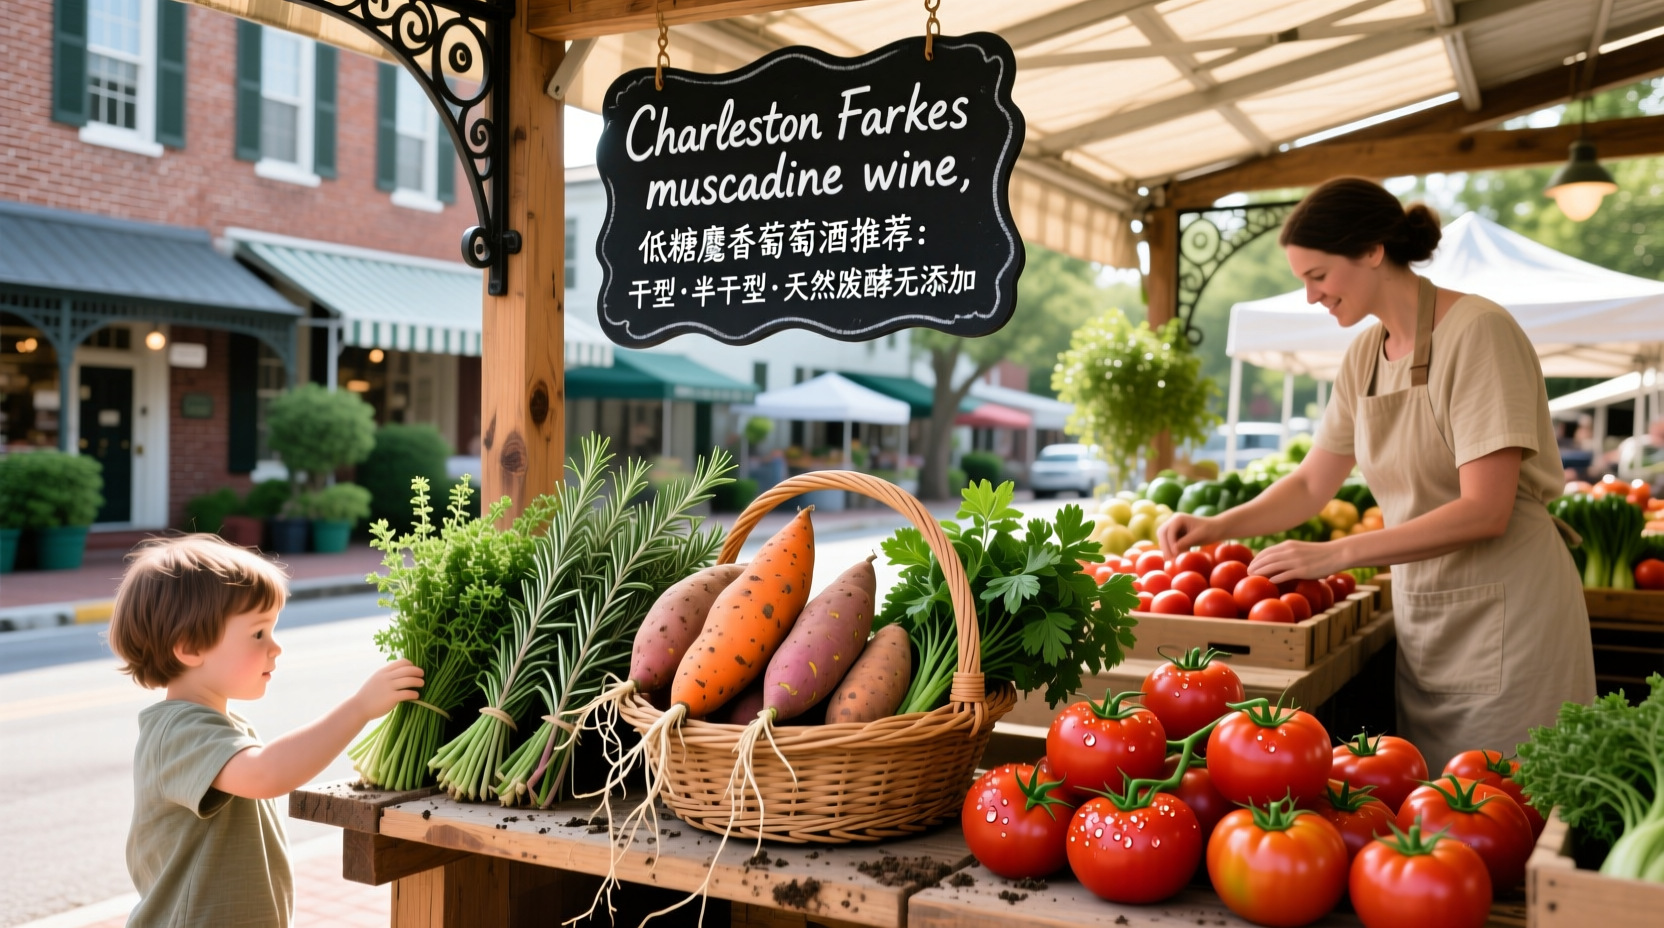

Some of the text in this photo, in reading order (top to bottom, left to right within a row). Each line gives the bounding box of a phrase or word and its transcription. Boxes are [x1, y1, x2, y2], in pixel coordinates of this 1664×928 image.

[626, 82, 969, 162] Charleston Farkes
[645, 151, 970, 210] muscadine wine,
